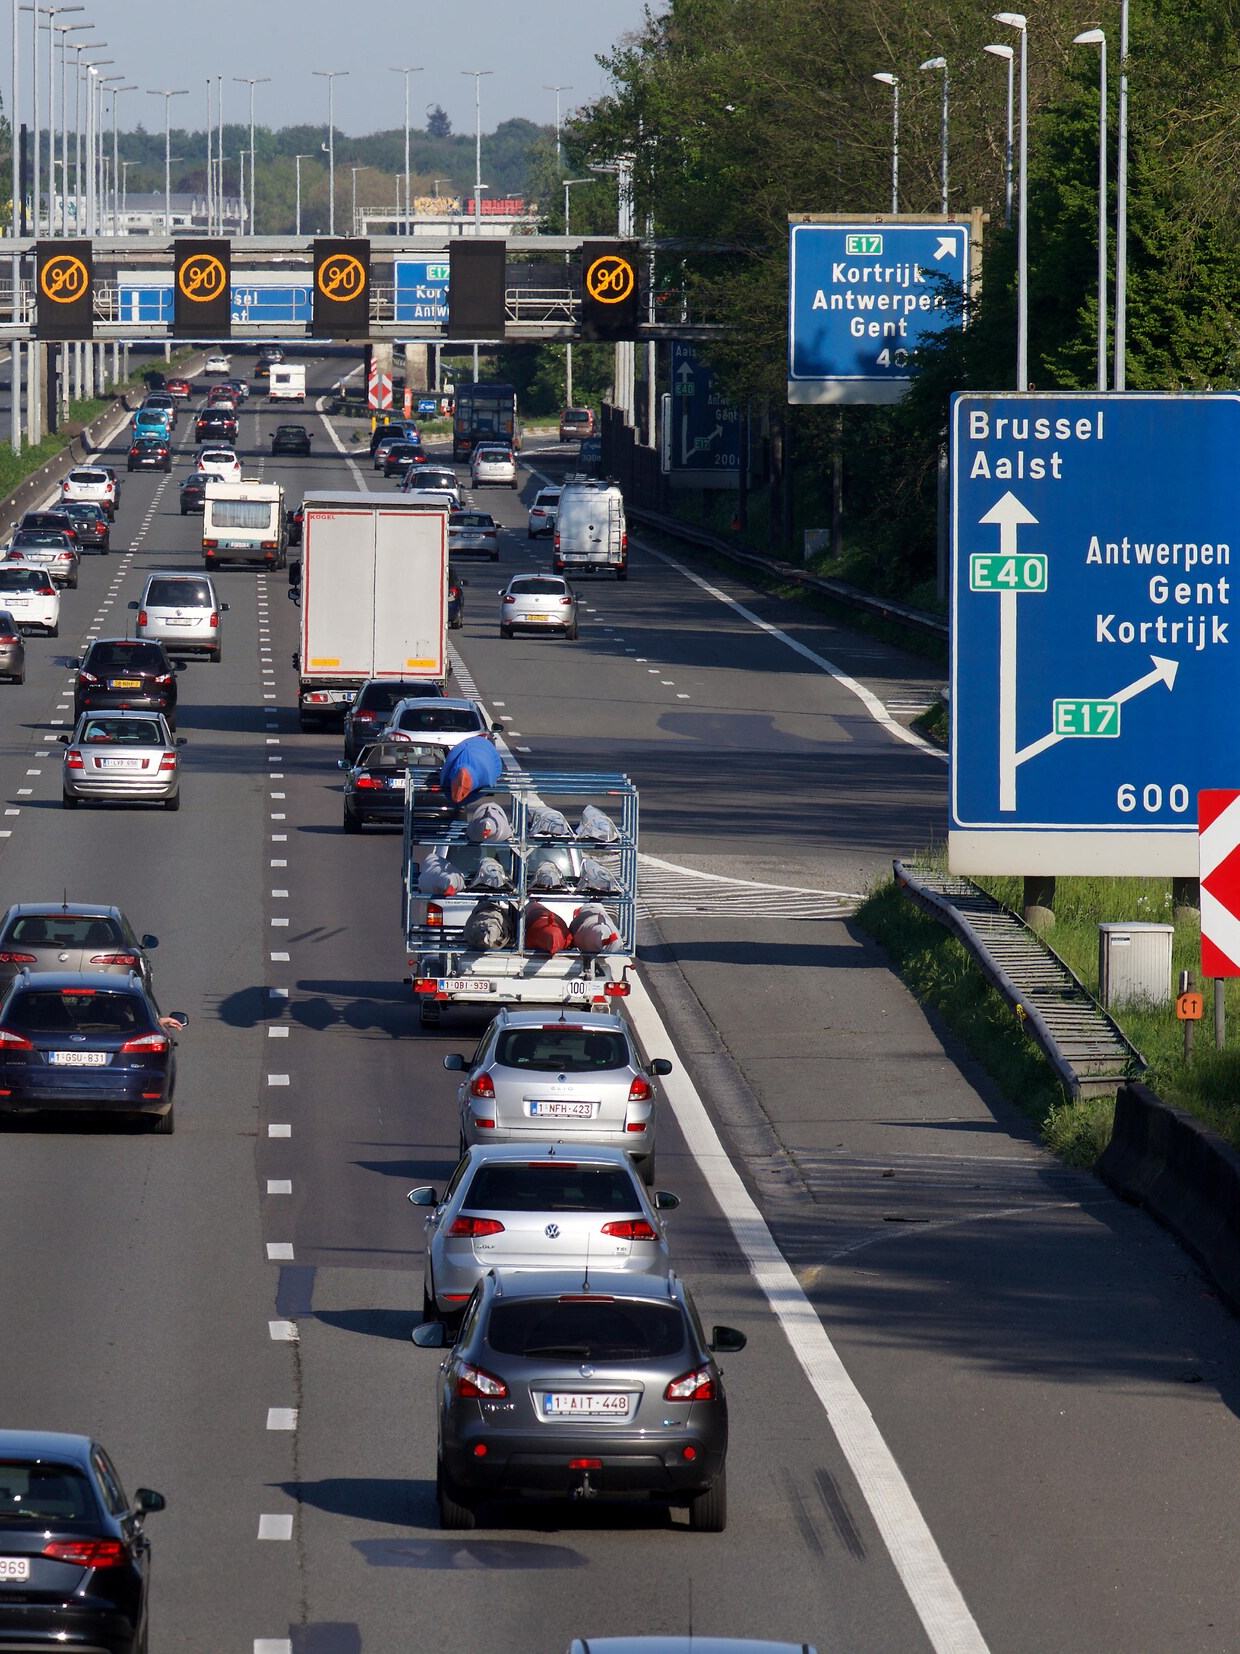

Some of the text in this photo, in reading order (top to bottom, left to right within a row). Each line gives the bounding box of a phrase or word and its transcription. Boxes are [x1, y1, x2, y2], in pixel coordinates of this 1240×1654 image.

[848, 237, 880, 253] E17
[832, 262, 926, 288] Kortrijk
[850, 316, 908, 338] Gent
[969, 410, 1104, 440] Brussel
[969, 450, 1063, 480] Aalst
[1085, 535, 1231, 573] Antwerpen
[973, 558, 1044, 588] E40
[1149, 575, 1230, 605] Gent
[1096, 614, 1229, 651] Kortrijk
[1057, 703, 1116, 733] E17
[1116, 783, 1190, 813] 600
[569, 981, 586, 995] 100
